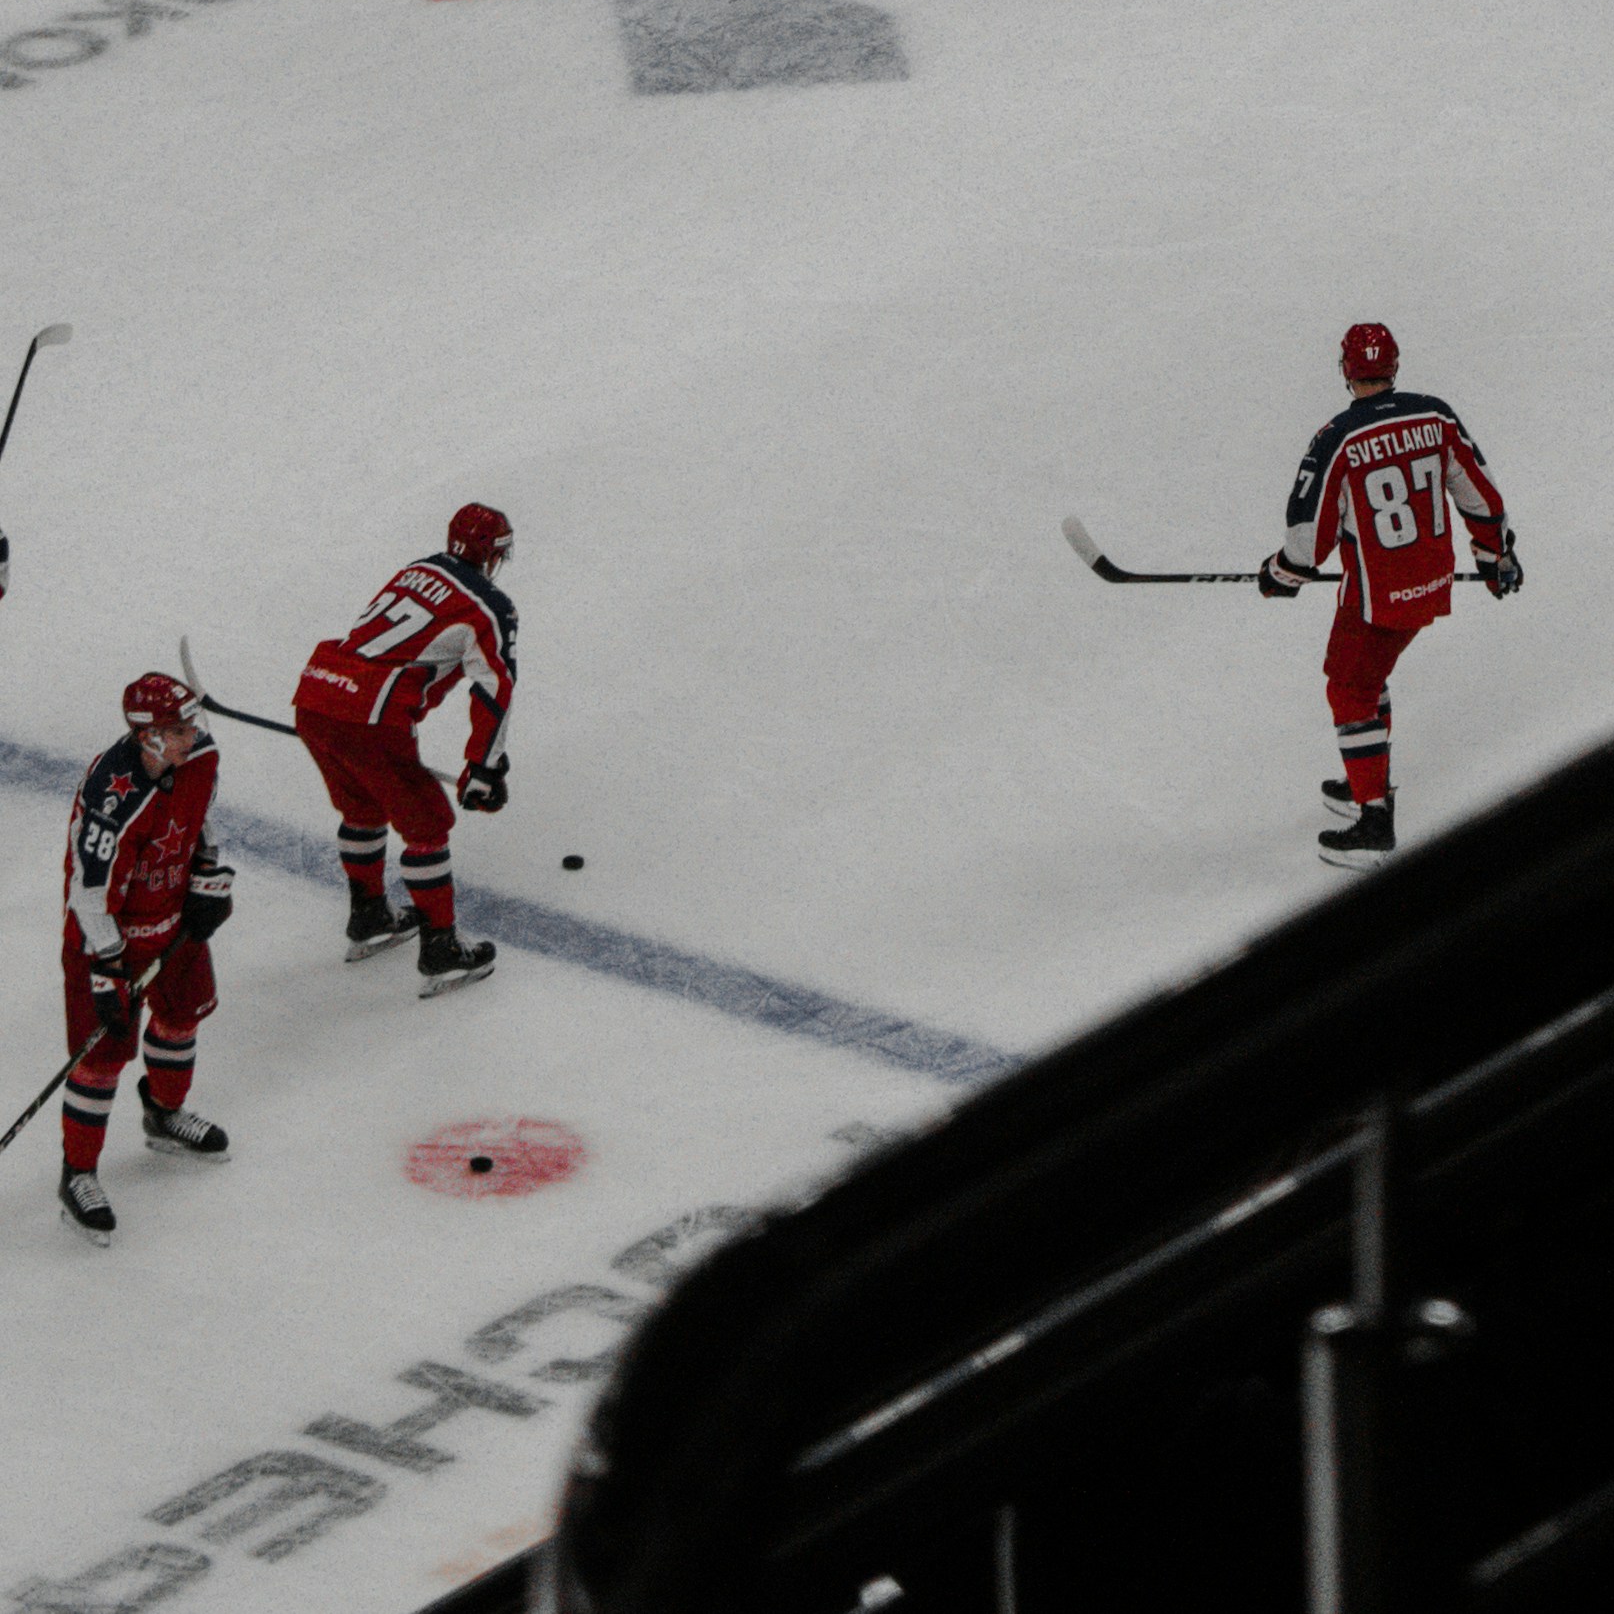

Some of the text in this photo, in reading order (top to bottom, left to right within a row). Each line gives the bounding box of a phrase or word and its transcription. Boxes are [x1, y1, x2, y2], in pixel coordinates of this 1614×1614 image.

[1345, 422, 1444, 469] SVETLAKOV
[1364, 453, 1447, 551] 87
[84, 820, 117, 862] 28
